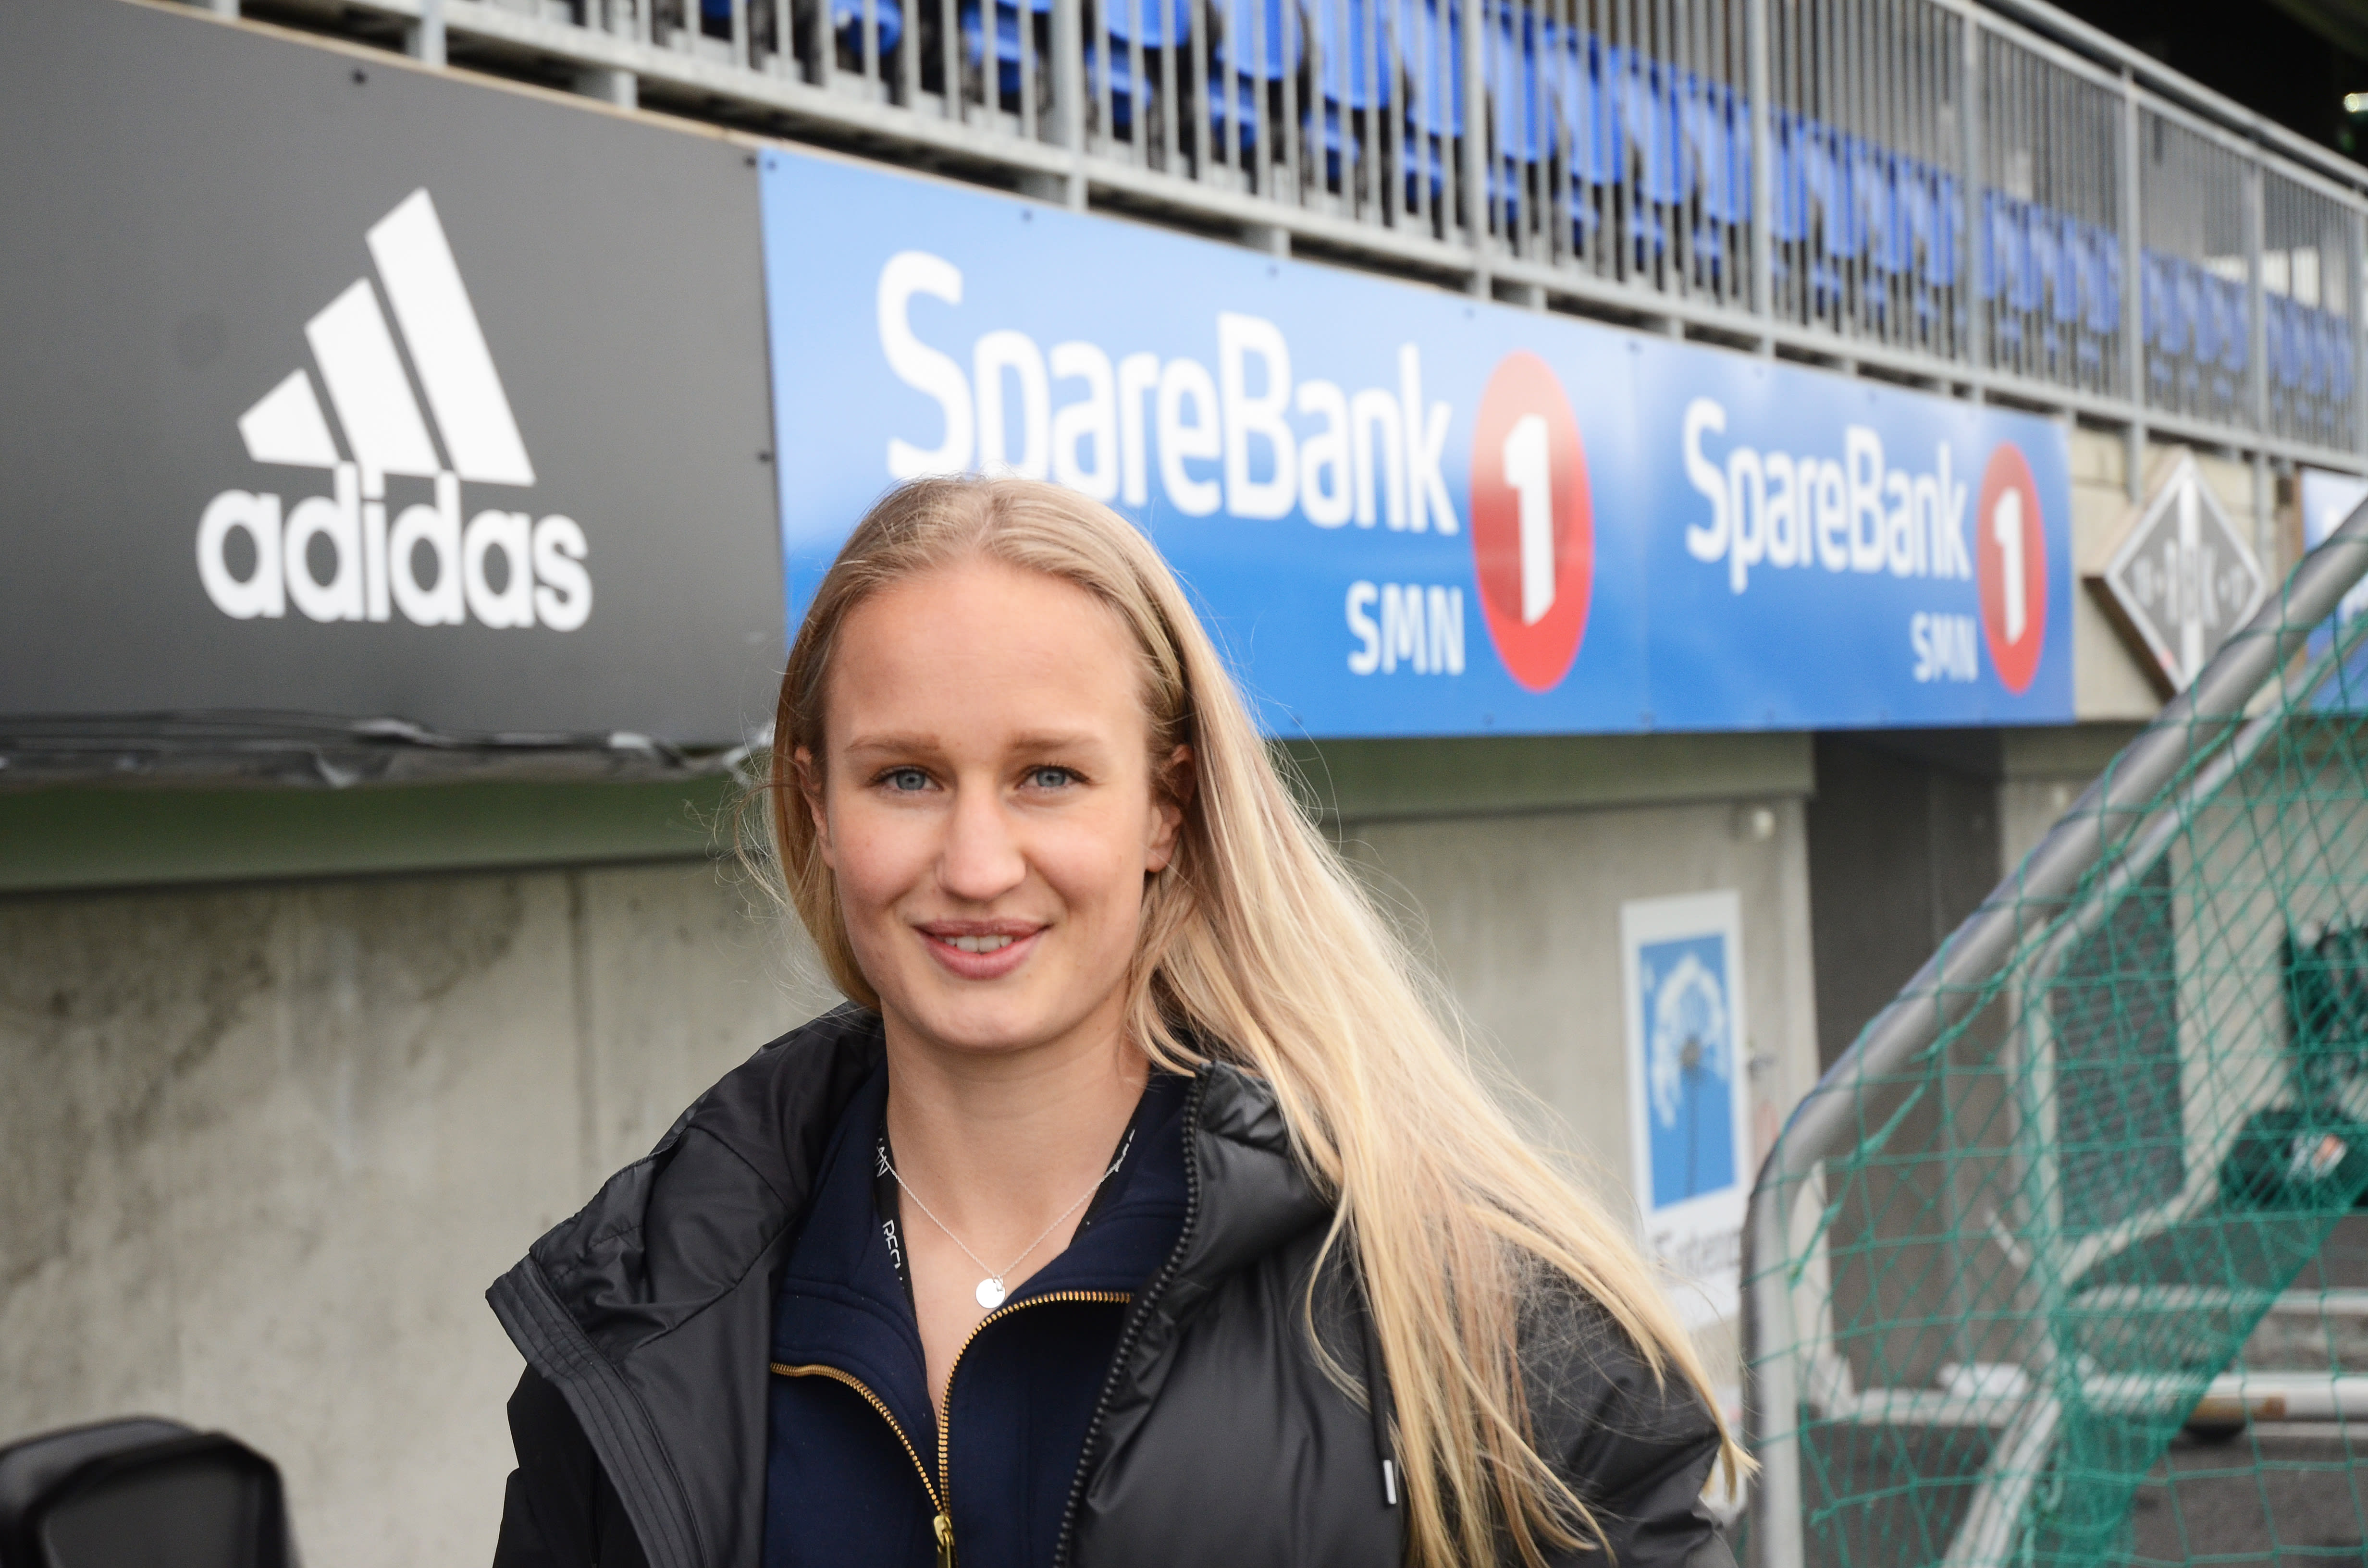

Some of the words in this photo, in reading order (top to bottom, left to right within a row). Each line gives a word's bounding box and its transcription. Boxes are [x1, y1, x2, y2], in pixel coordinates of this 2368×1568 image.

[878, 251, 1459, 535] SpareBank
[1503, 414, 1555, 625] 1
[1683, 397, 1972, 595] SpareBank
[1994, 487, 2027, 645] 1
[196, 460, 593, 632] adidas
[1347, 581, 1464, 675] SMN
[1911, 611, 1978, 683] SMN
